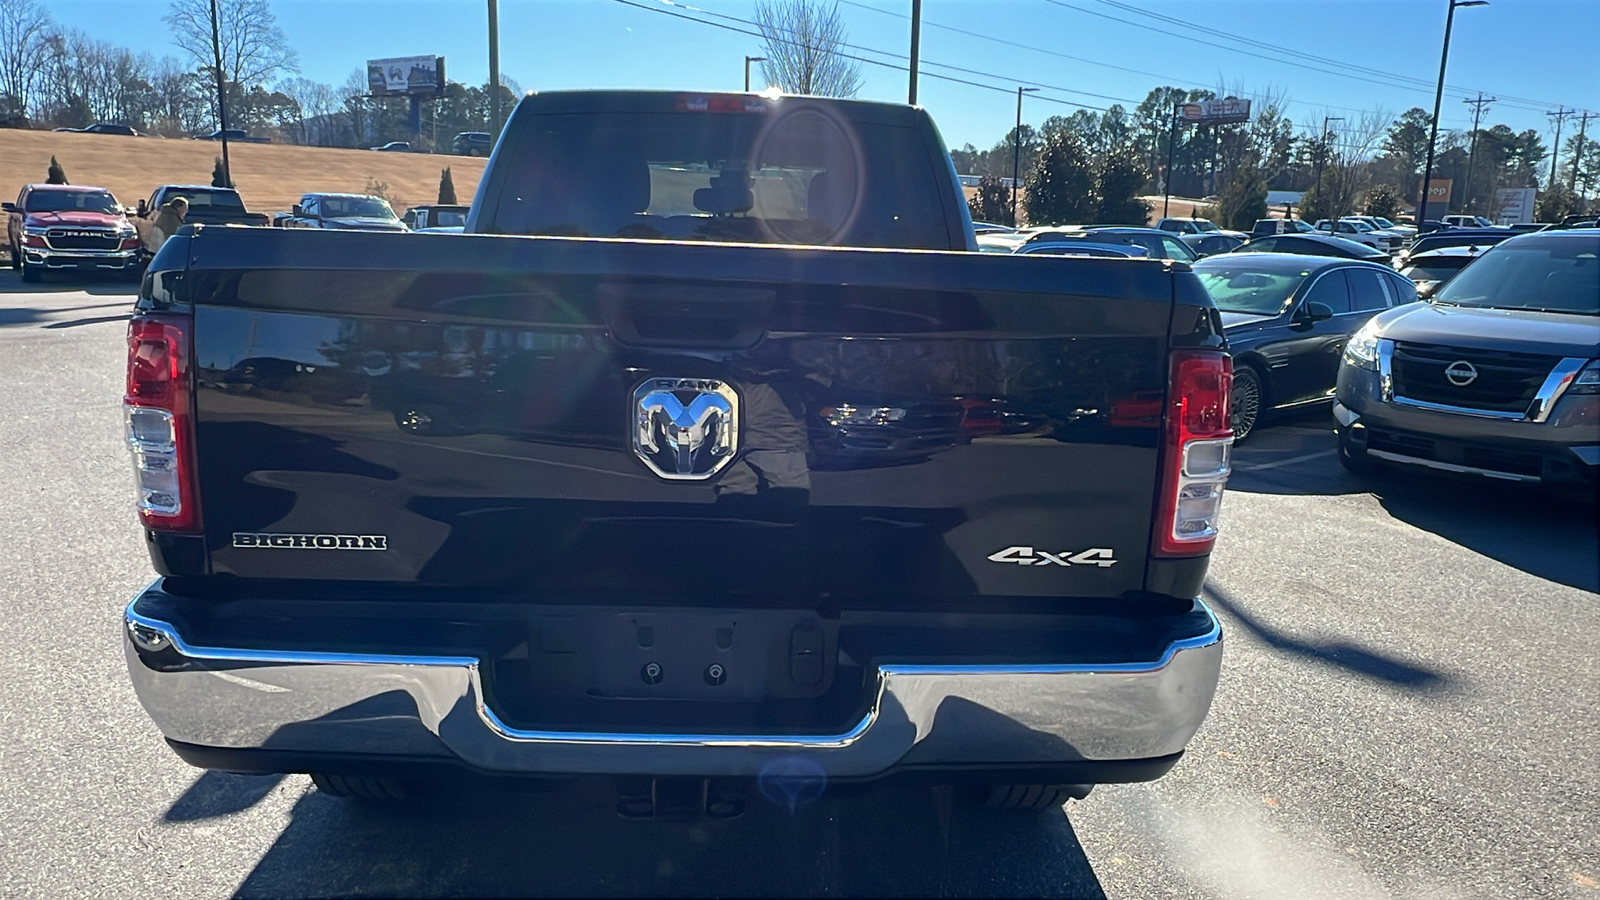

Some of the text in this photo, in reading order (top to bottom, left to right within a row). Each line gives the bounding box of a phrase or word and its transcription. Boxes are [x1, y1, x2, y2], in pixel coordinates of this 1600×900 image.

[656, 380, 721, 391] RAM
[232, 532, 388, 550] BIGHORN
[987, 546, 1118, 567] 4x4
